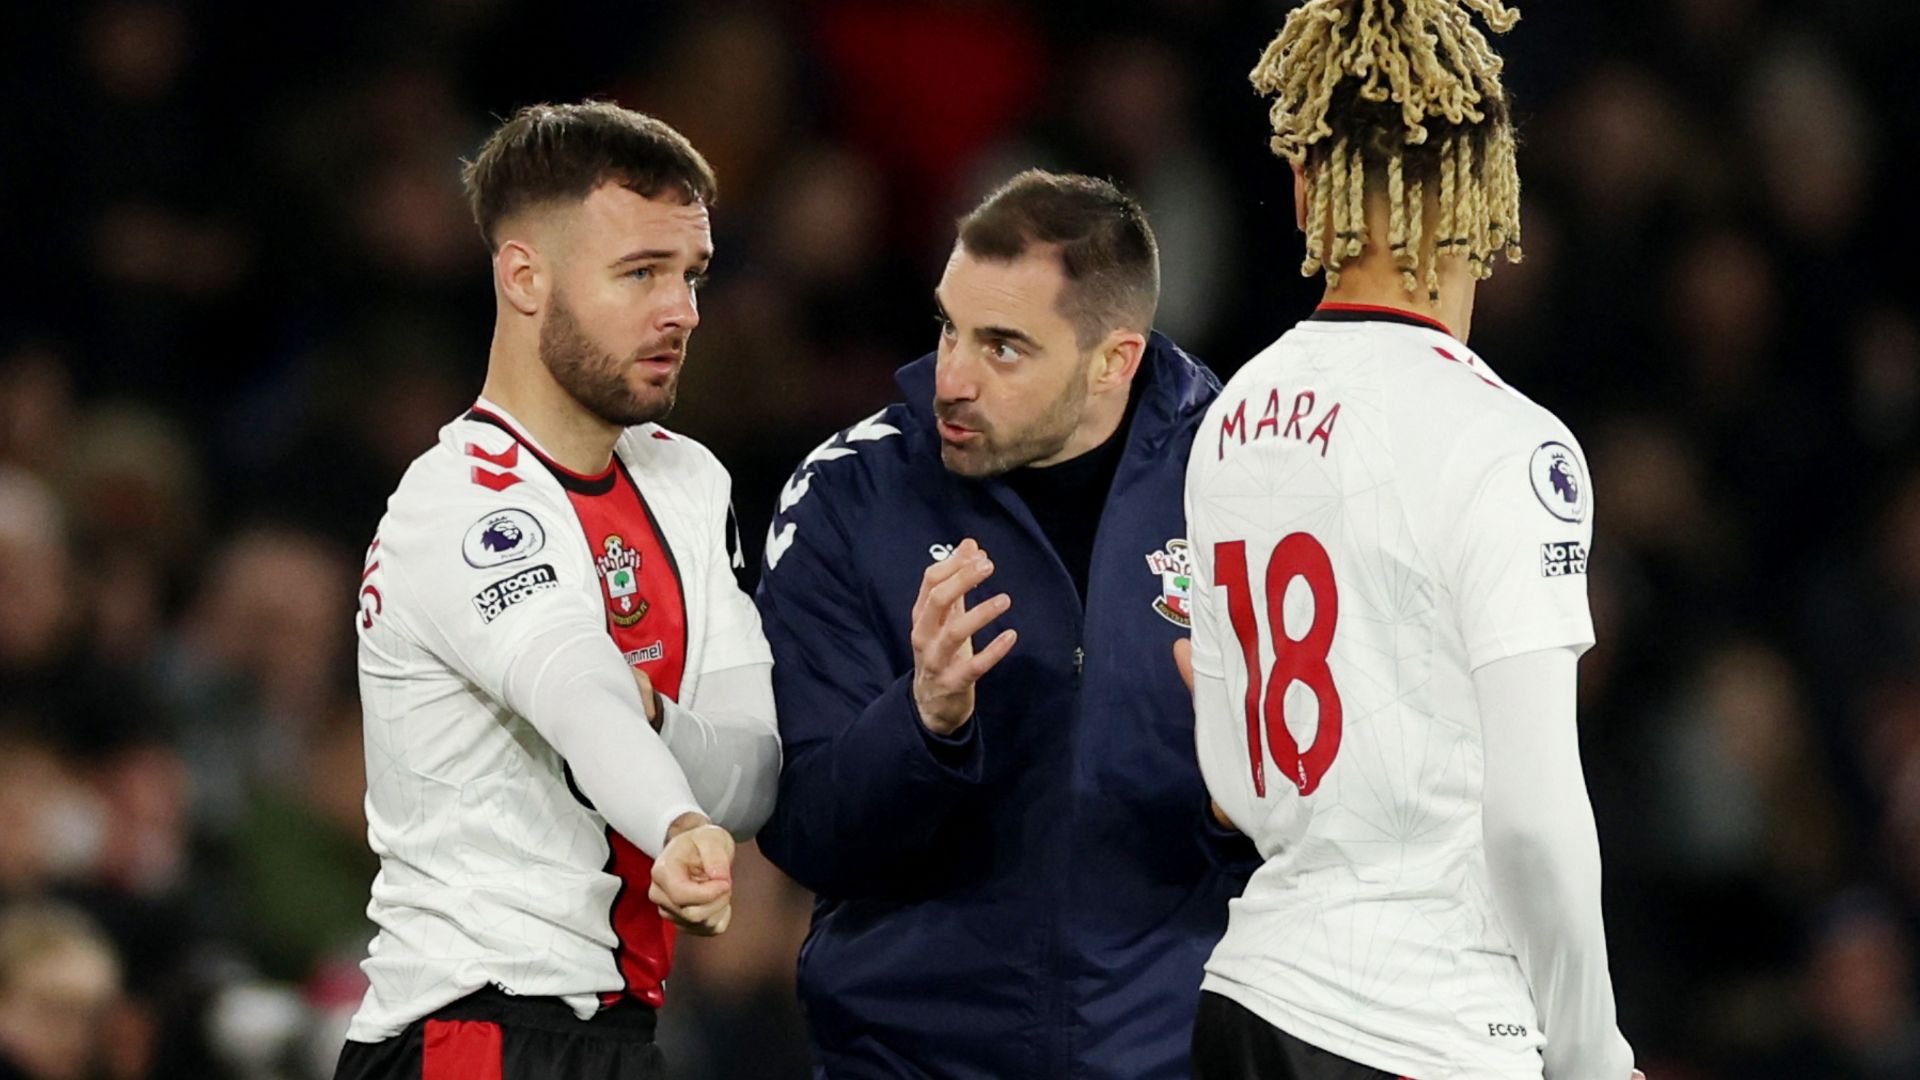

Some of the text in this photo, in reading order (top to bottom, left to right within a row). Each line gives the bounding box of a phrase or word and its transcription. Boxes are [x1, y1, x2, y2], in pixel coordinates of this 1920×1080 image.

[1218, 388, 1341, 461] MARA
[1541, 543, 1585, 561] No ro
[1541, 560, 1568, 577] for
[472, 567, 550, 607] No room
[624, 641, 662, 665] ummel
[1213, 531, 1343, 797] 18
